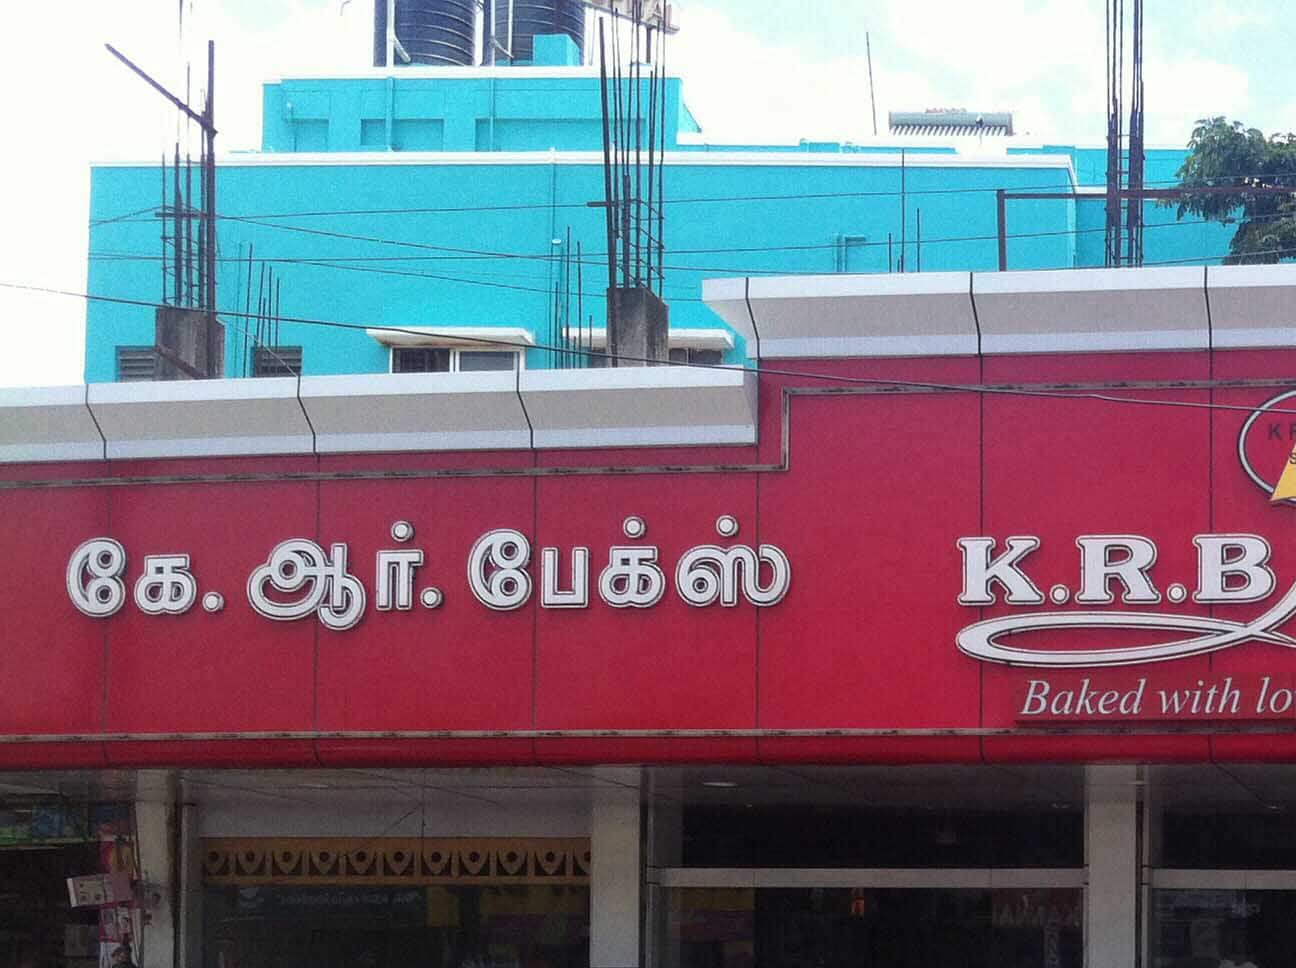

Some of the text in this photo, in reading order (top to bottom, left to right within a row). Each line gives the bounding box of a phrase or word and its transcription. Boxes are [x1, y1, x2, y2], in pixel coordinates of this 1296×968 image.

[1267, 423, 1283, 440] K
[66, 513, 793, 632] கே. ஆர். பேக்ஸ்
[1020, 678, 1145, 716] Baked
[1159, 676, 1240, 714] with
